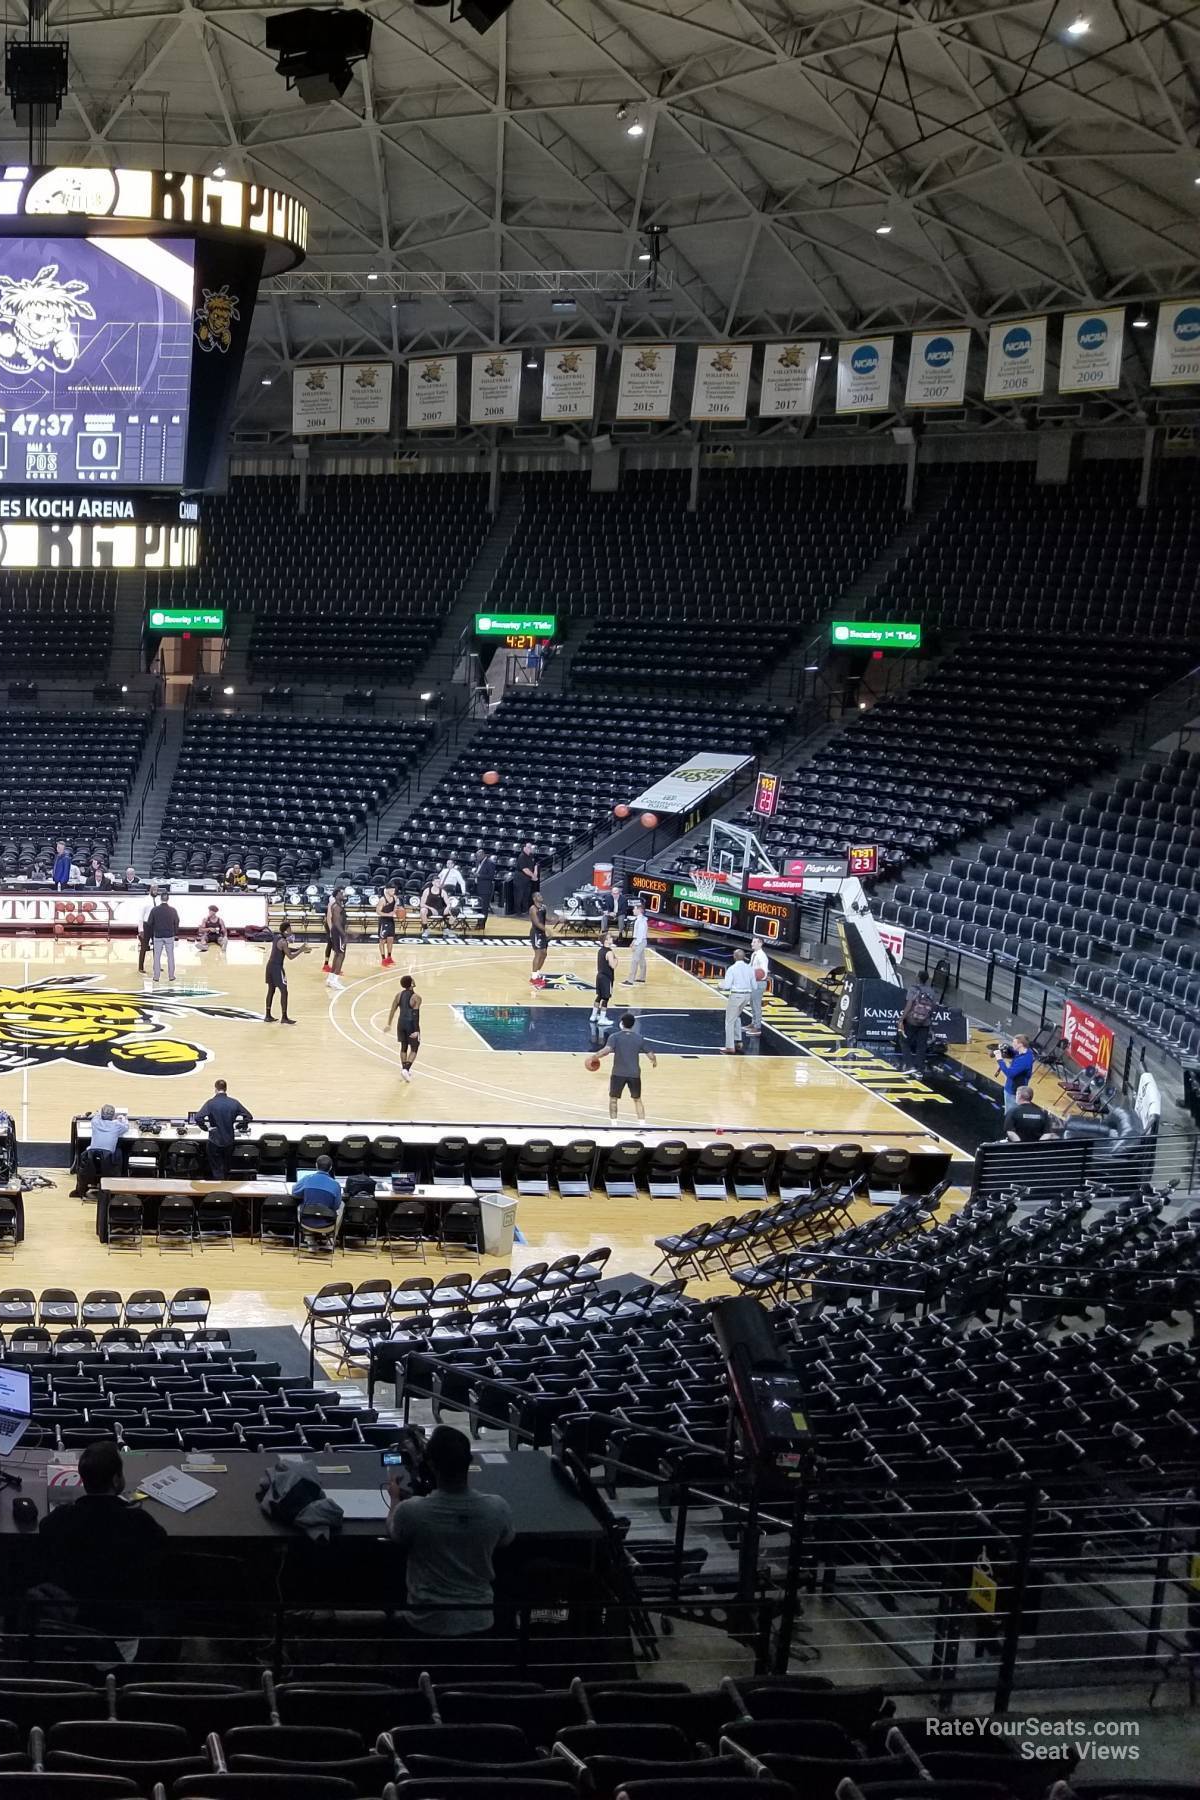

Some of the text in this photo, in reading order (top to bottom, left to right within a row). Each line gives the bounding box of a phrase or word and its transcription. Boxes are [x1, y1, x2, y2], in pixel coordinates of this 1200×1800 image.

[1005, 341, 1032, 352] NCAA
[927, 351, 954, 361] NCAA
[853, 359, 878, 368] NCAA
[1171, 363, 1199, 375] 2010
[1076, 370, 1103, 383] 2009
[1001, 378, 1028, 390] 2008
[922, 386, 949, 398] 2007
[852, 393, 874, 404] 2004
[557, 403, 578, 413] 2013
[633, 402, 654, 411] 2015
[707, 403, 729, 412] 2016
[775, 400, 797, 410] 2017
[422, 411, 443, 421] 2007
[484, 407, 504, 416] 2008
[12, 414, 74, 436] 47:37
[306, 419, 326, 428] 2004
[355, 417, 376, 426] 2005
[92, 438, 106, 460] 0
[26, 454, 57, 471] POS
[25, 498, 74, 518] KOCH
[78, 499, 134, 518] ARENA
[506, 635, 533, 648] 4:27
[804, 863, 842, 873] Pizza Hut
[855, 859, 870, 870] 23
[632, 876, 668, 892] SHOCKERS
[651, 895, 659, 912] 0
[748, 900, 788, 918] BEARCATS
[681, 902, 719, 923] 47:37
[768, 920, 778, 937] 0
[863, 1007, 905, 1019] KANSAS
